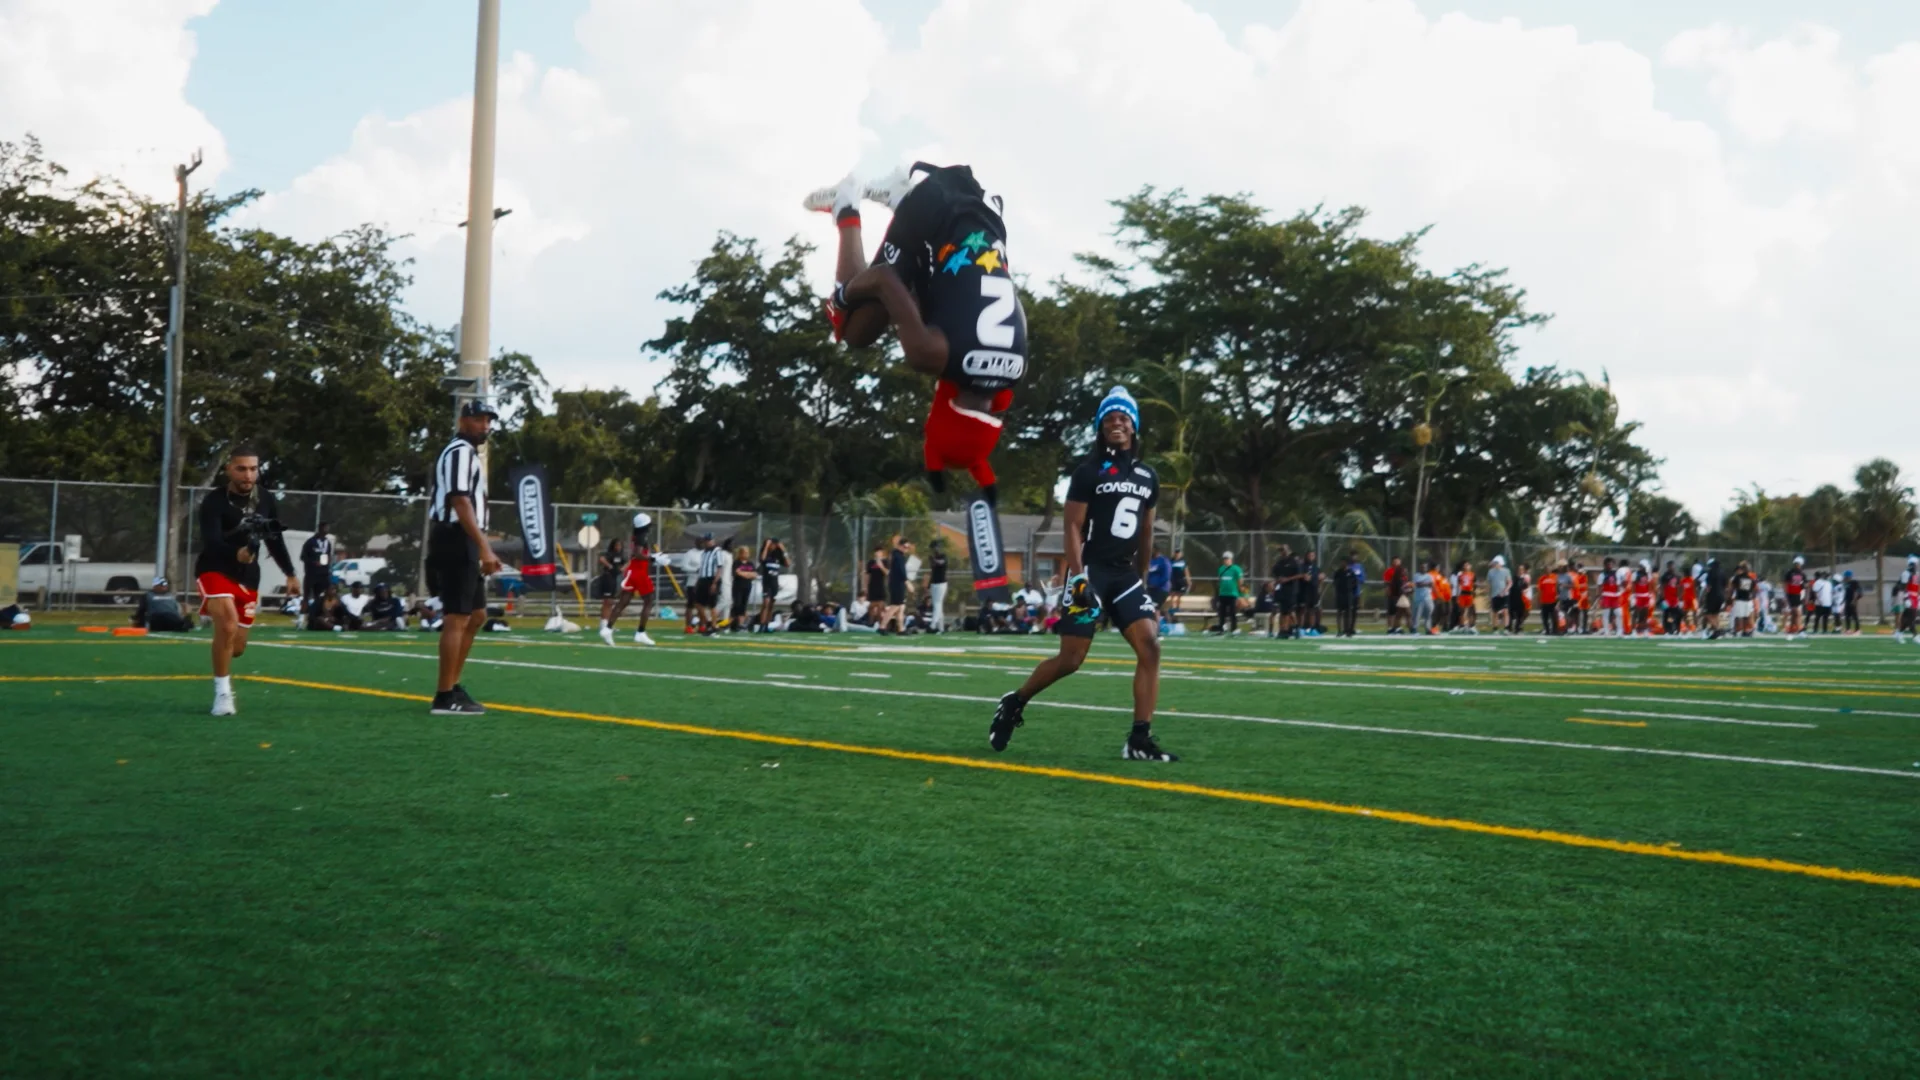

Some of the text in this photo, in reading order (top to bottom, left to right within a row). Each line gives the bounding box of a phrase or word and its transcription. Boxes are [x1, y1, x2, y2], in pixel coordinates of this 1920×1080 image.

[976, 274, 1015, 349] 2
[523, 483, 542, 550] BATTLE
[1110, 496, 1141, 539] 6
